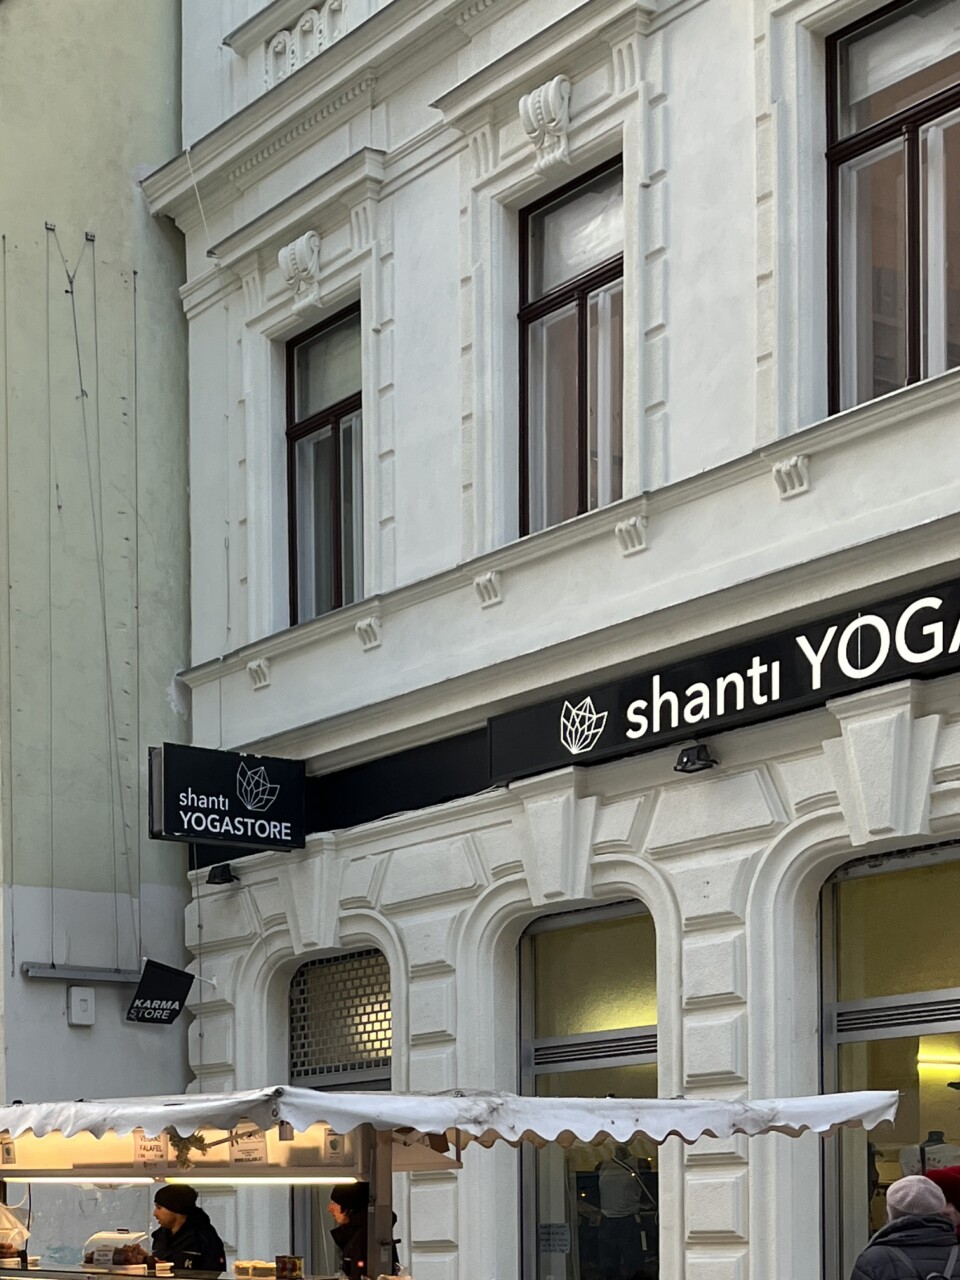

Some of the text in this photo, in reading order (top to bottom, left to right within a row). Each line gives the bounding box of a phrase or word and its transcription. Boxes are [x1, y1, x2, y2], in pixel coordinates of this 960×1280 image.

[626, 597, 960, 738] shanti YOG
[179, 787, 229, 810] shanti
[179, 810, 292, 840] YOGASTORE
[130, 1008, 170, 1020] STORE
[133, 999, 179, 1010] KARMA
